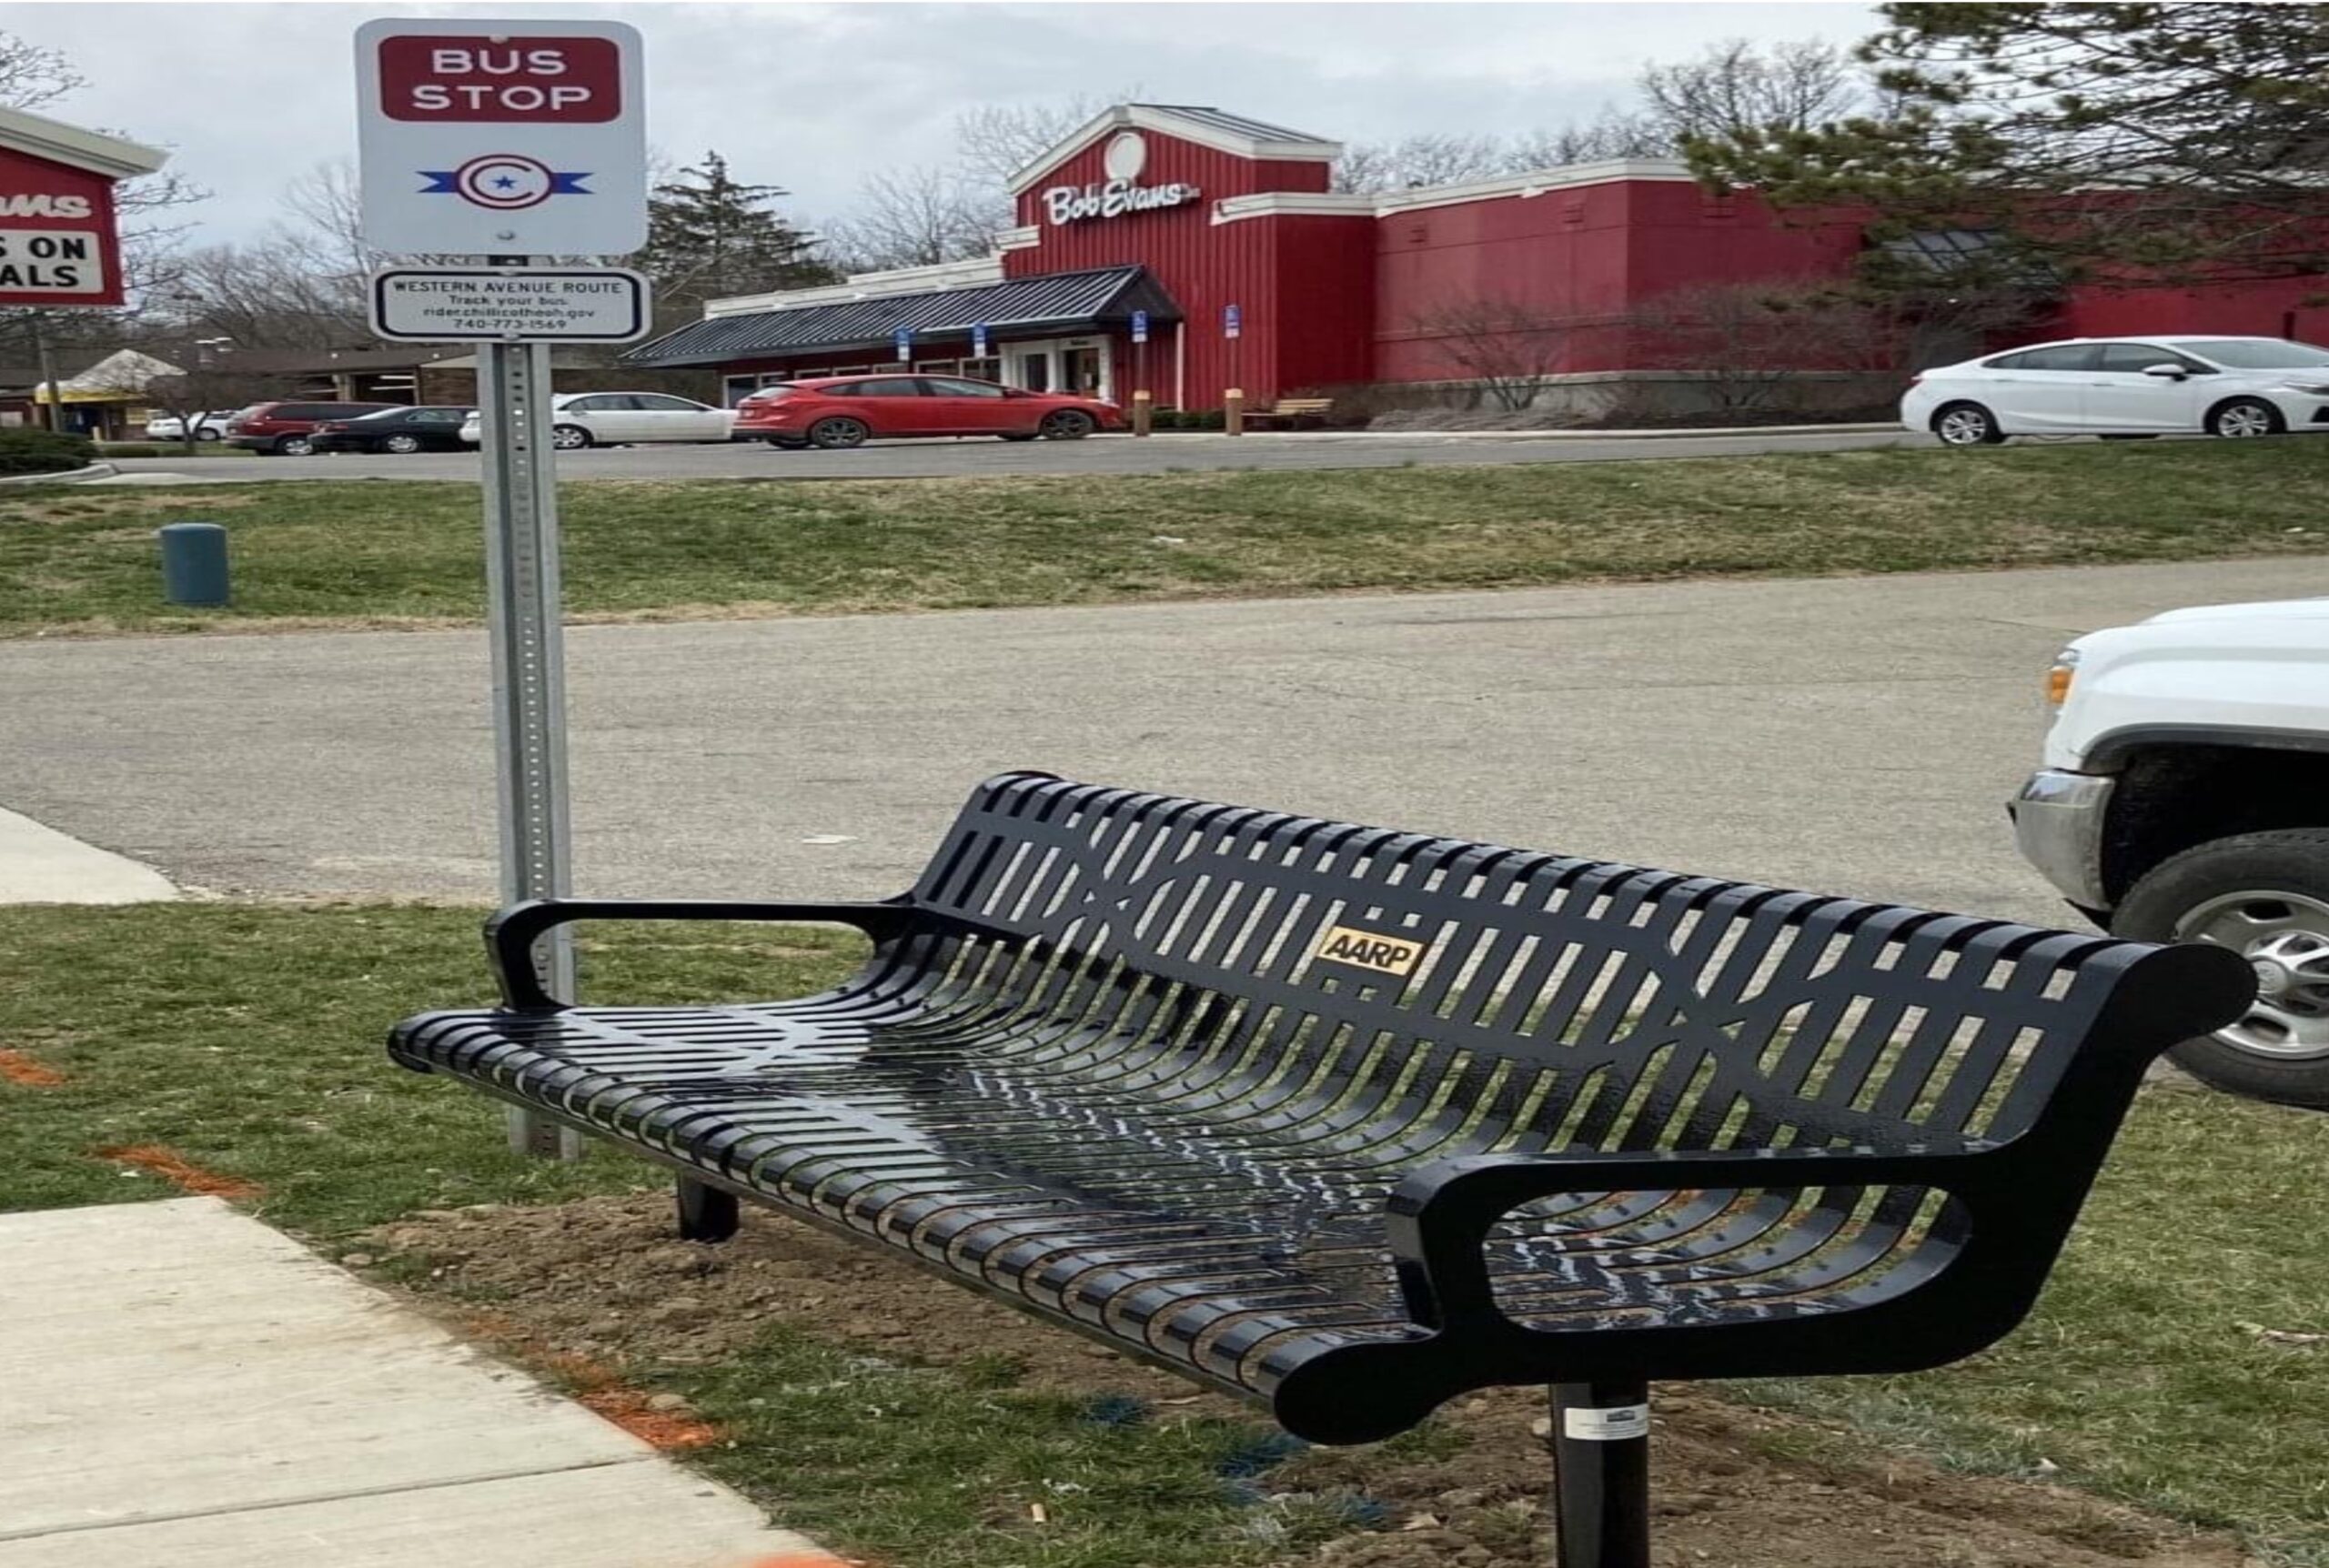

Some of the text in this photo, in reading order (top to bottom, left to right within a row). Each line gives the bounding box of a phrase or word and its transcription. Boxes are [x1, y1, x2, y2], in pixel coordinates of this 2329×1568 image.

[432, 49, 567, 75] BUS
[412, 85, 591, 110] STOP
[1043, 180, 1184, 226] Bob Evans
[28, 236, 86, 259] ON
[0, 265, 79, 287] ALS
[393, 281, 623, 294] WESTERN AVENUE ROUTE
[449, 295, 489, 305] Track
[497, 297, 532, 307] your
[453, 319, 567, 329] 740-773-1569
[1324, 934, 1413, 969] AARP
